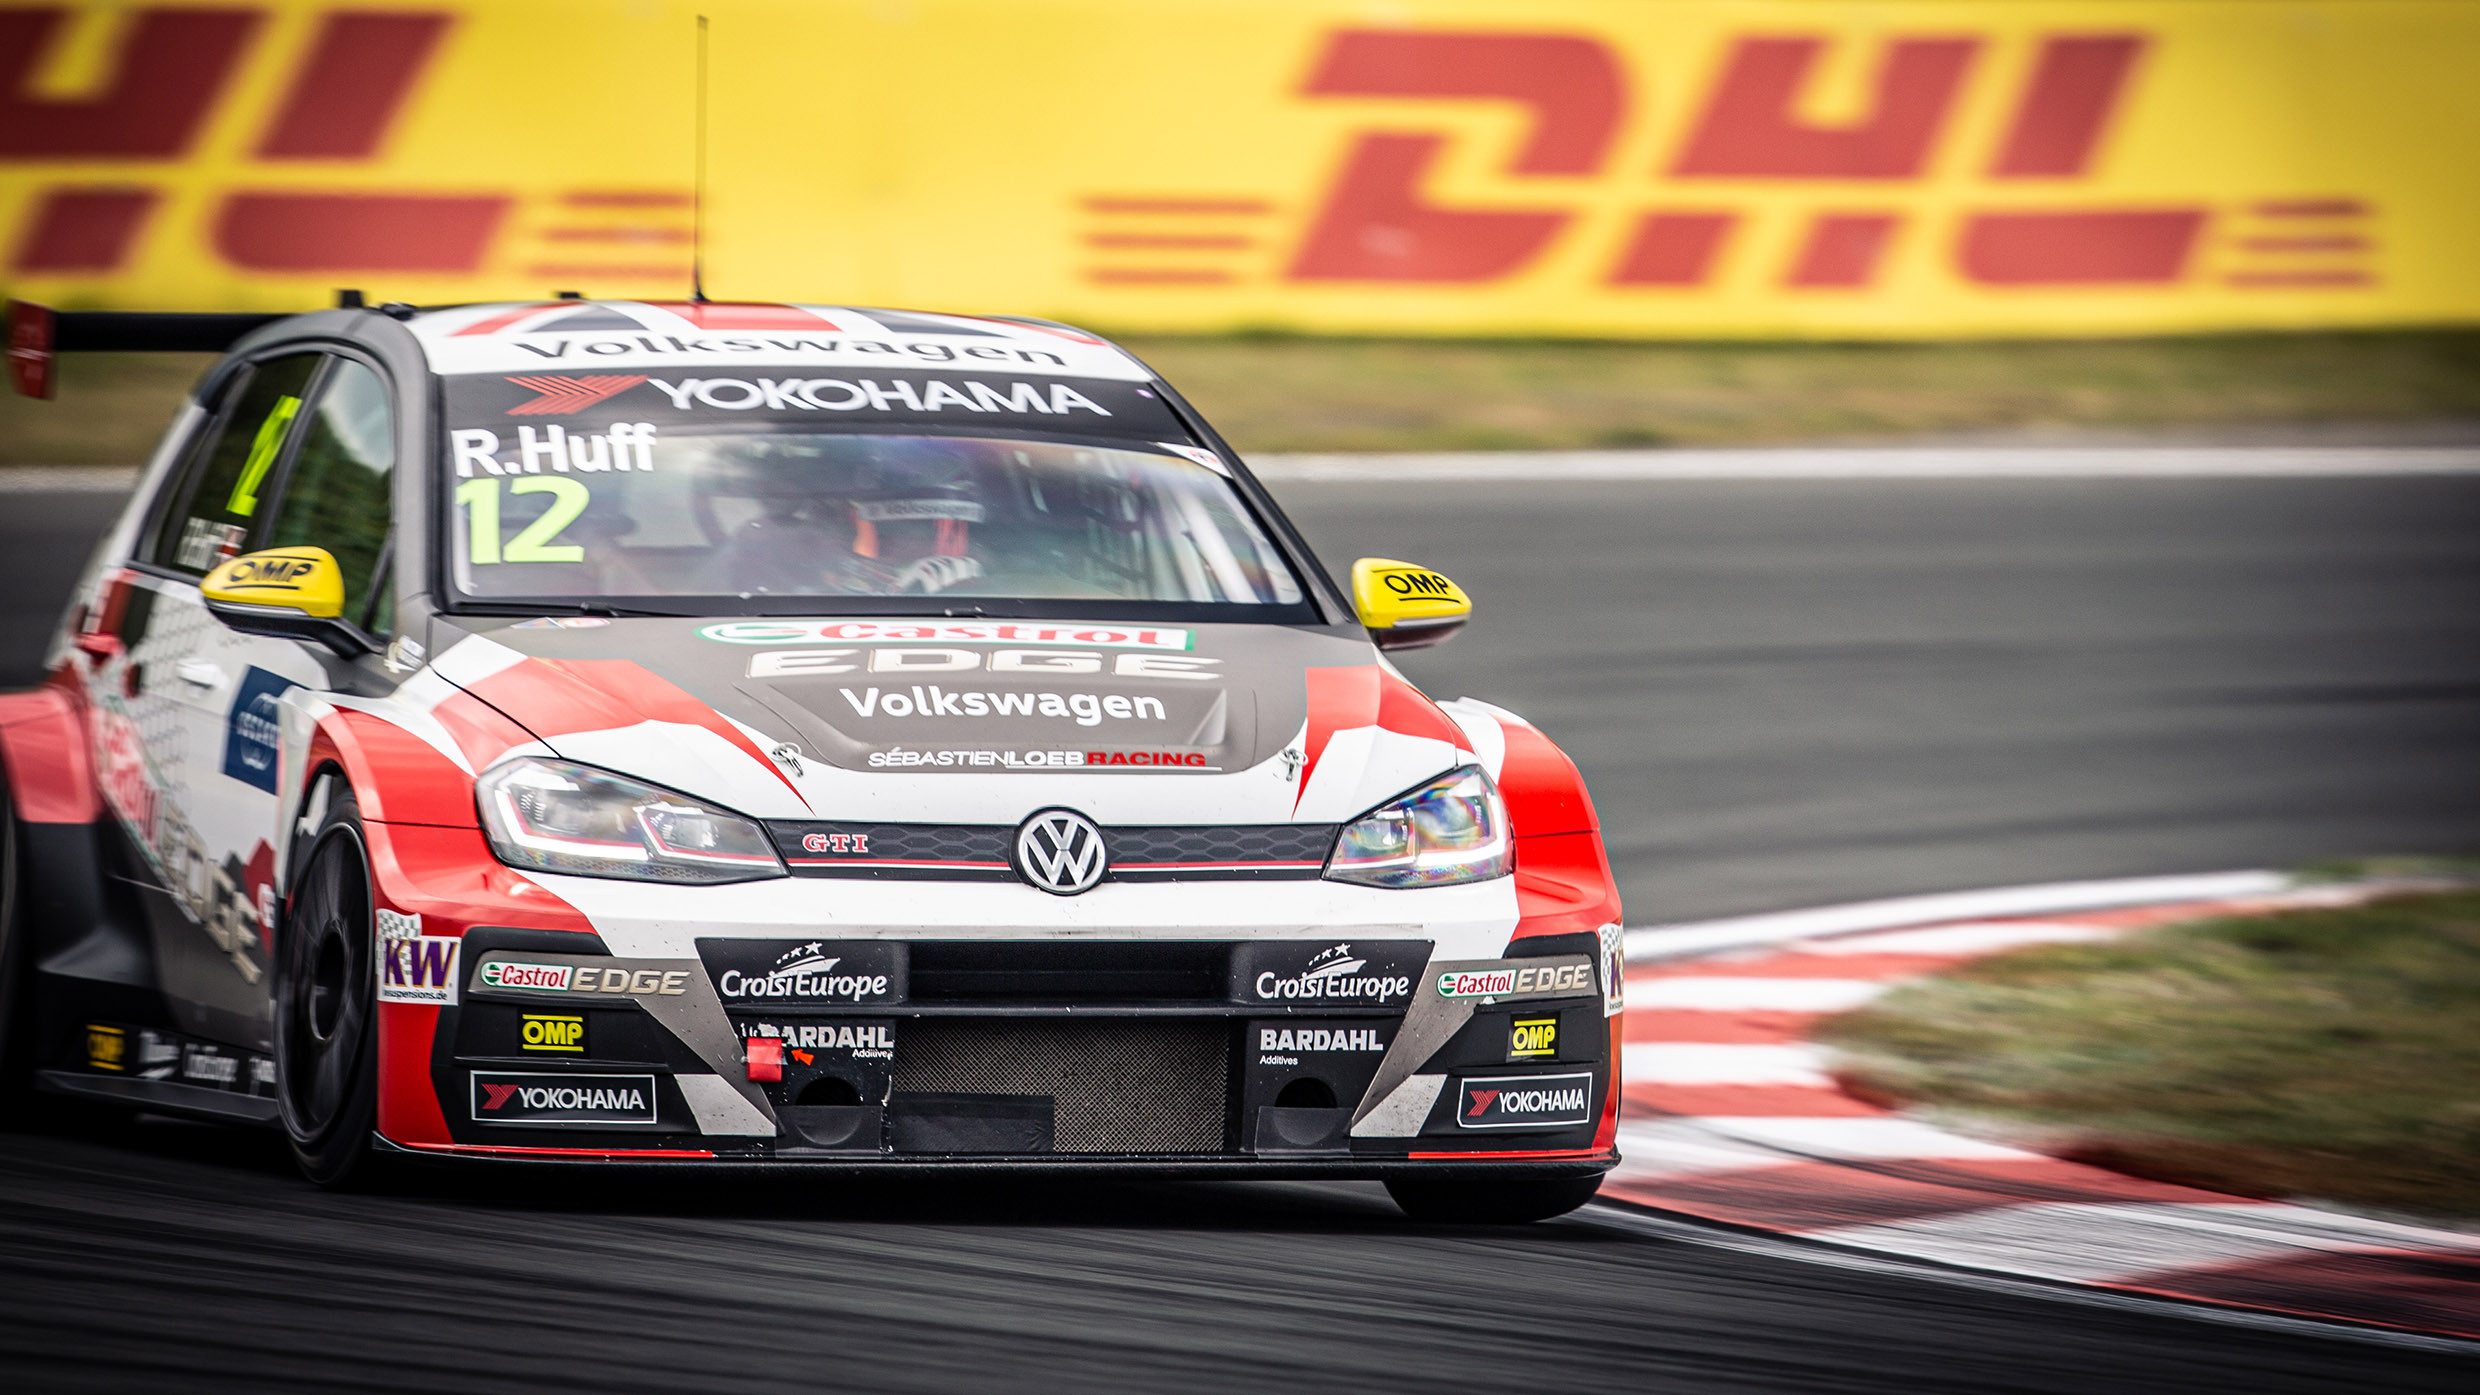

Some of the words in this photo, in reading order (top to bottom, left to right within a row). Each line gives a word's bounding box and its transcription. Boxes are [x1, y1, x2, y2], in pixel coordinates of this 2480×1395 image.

[0, 8, 515, 275] HL
[1282, 27, 2205, 288] DHL
[515, 336, 1067, 368] Volkswagen
[647, 377, 1112, 416] YOKOHAMA
[451, 422, 657, 477] R.Huff
[455, 475, 590, 564] 12
[228, 561, 313, 583] OMP
[1384, 573, 1449, 595] OMP
[819, 622, 1171, 648] Castrol
[746, 648, 1225, 680] EDGE
[839, 685, 1167, 727] Volkswagen
[802, 833, 869, 854] GTI
[384, 938, 459, 989] KW
[1457, 973, 1512, 994] Castrol
[1514, 963, 1592, 994] EDGE
[1609, 950, 1624, 999] K
[502, 964, 567, 988] Castrol
[571, 966, 691, 996] EDGE
[720, 969, 888, 1002] CroisiEurope
[1256, 971, 1409, 1003] CroisiEurope
[522, 1020, 584, 1046] OMP
[1260, 1028, 1384, 1051] BARDAHL
[1512, 1025, 1556, 1050] OMP
[1259, 1055, 1299, 1066] Additives
[518, 1086, 646, 1111] YOKOHAMA
[1499, 1088, 1585, 1113] YOKOHAMA
